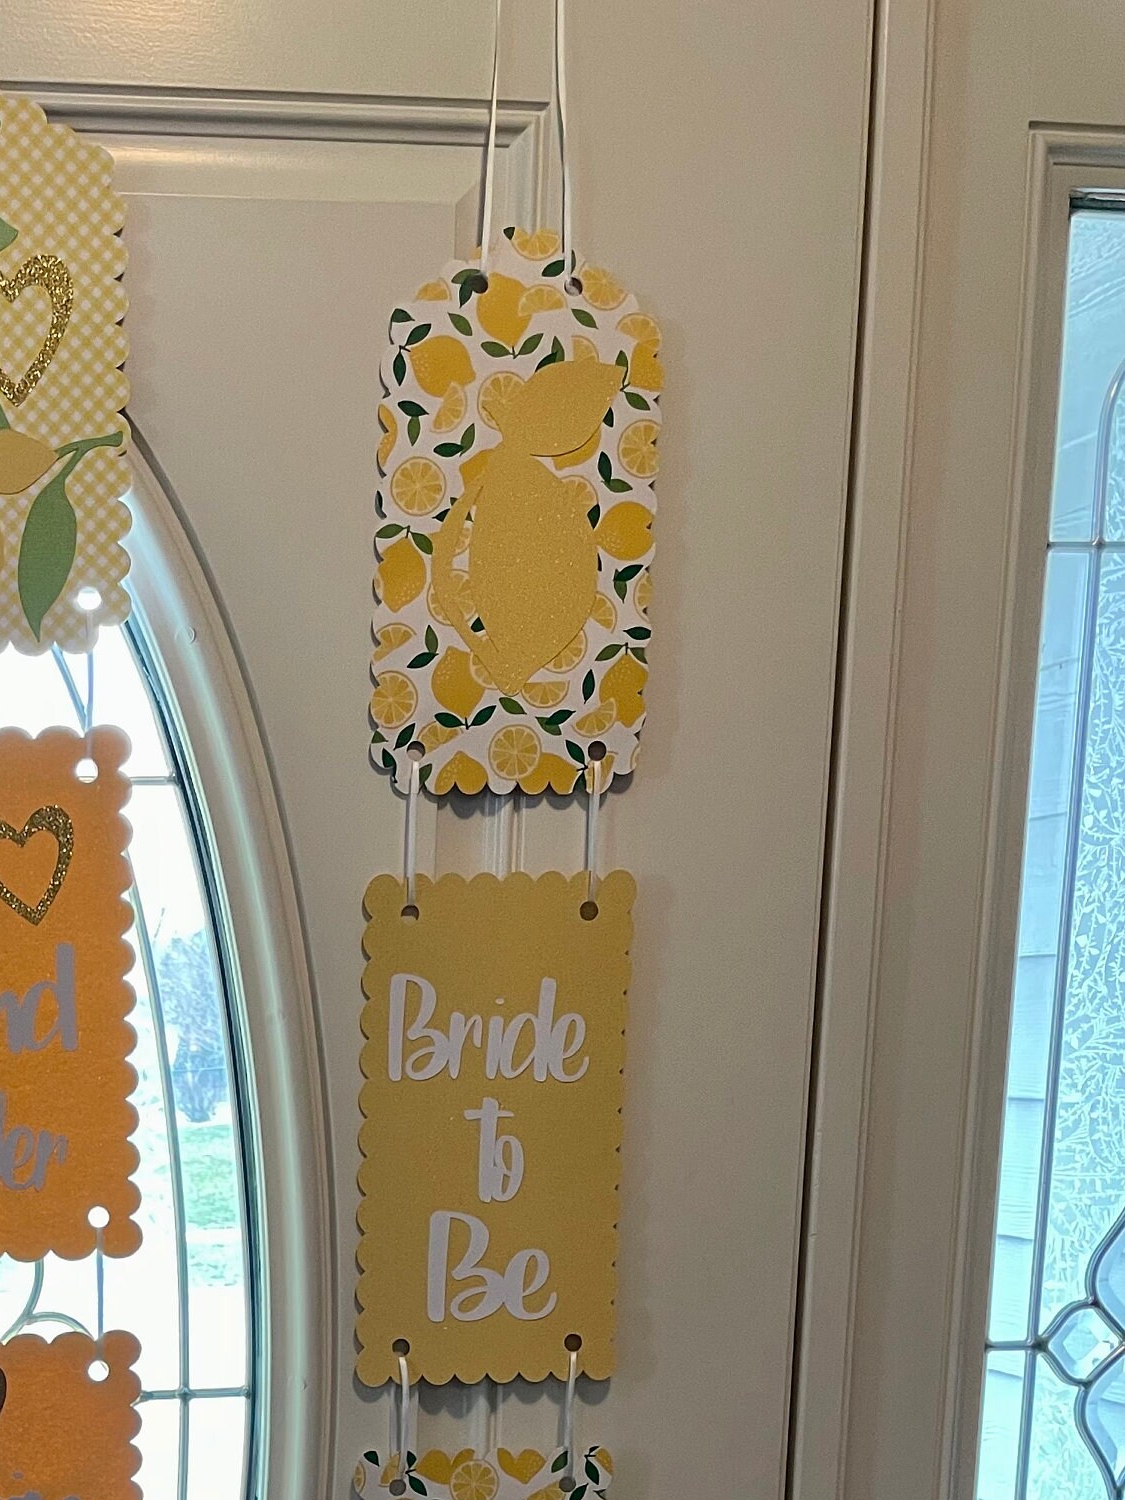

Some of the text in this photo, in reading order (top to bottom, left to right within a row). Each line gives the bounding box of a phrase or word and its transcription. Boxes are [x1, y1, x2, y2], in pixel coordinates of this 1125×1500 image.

[388, 973, 590, 1083] Bride
[463, 1096, 525, 1203] to
[427, 1210, 558, 1323] Be
